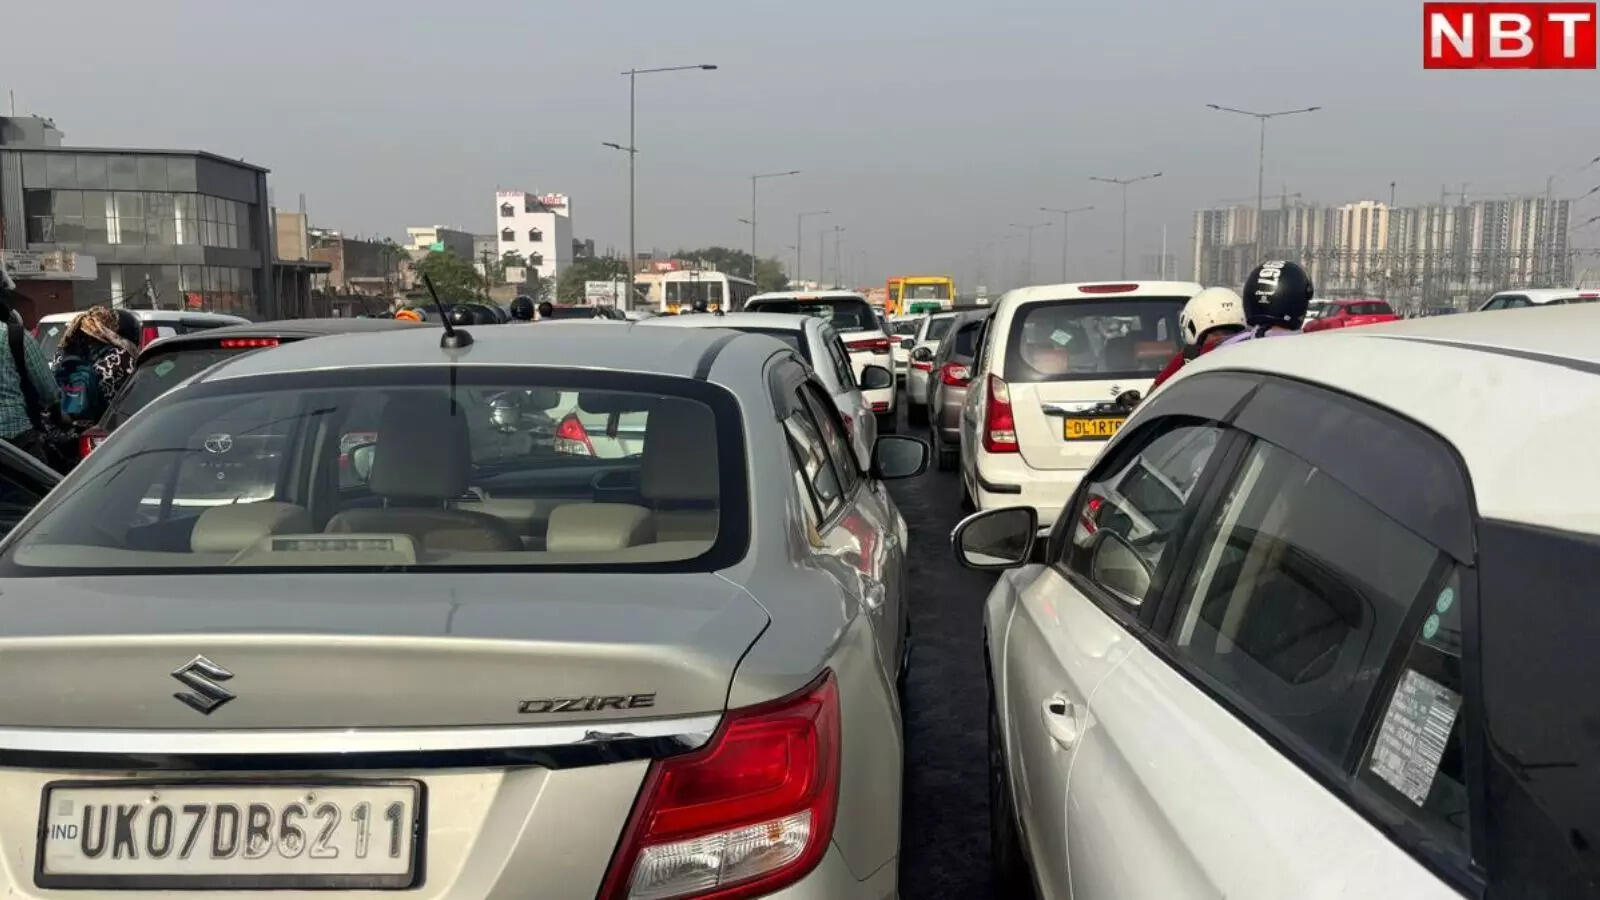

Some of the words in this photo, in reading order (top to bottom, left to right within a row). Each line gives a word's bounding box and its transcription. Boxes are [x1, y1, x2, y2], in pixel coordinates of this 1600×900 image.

[518, 692, 656, 714] DZIRE
[52, 823, 78, 839] IND
[81, 801, 404, 860] UK07DB6211
